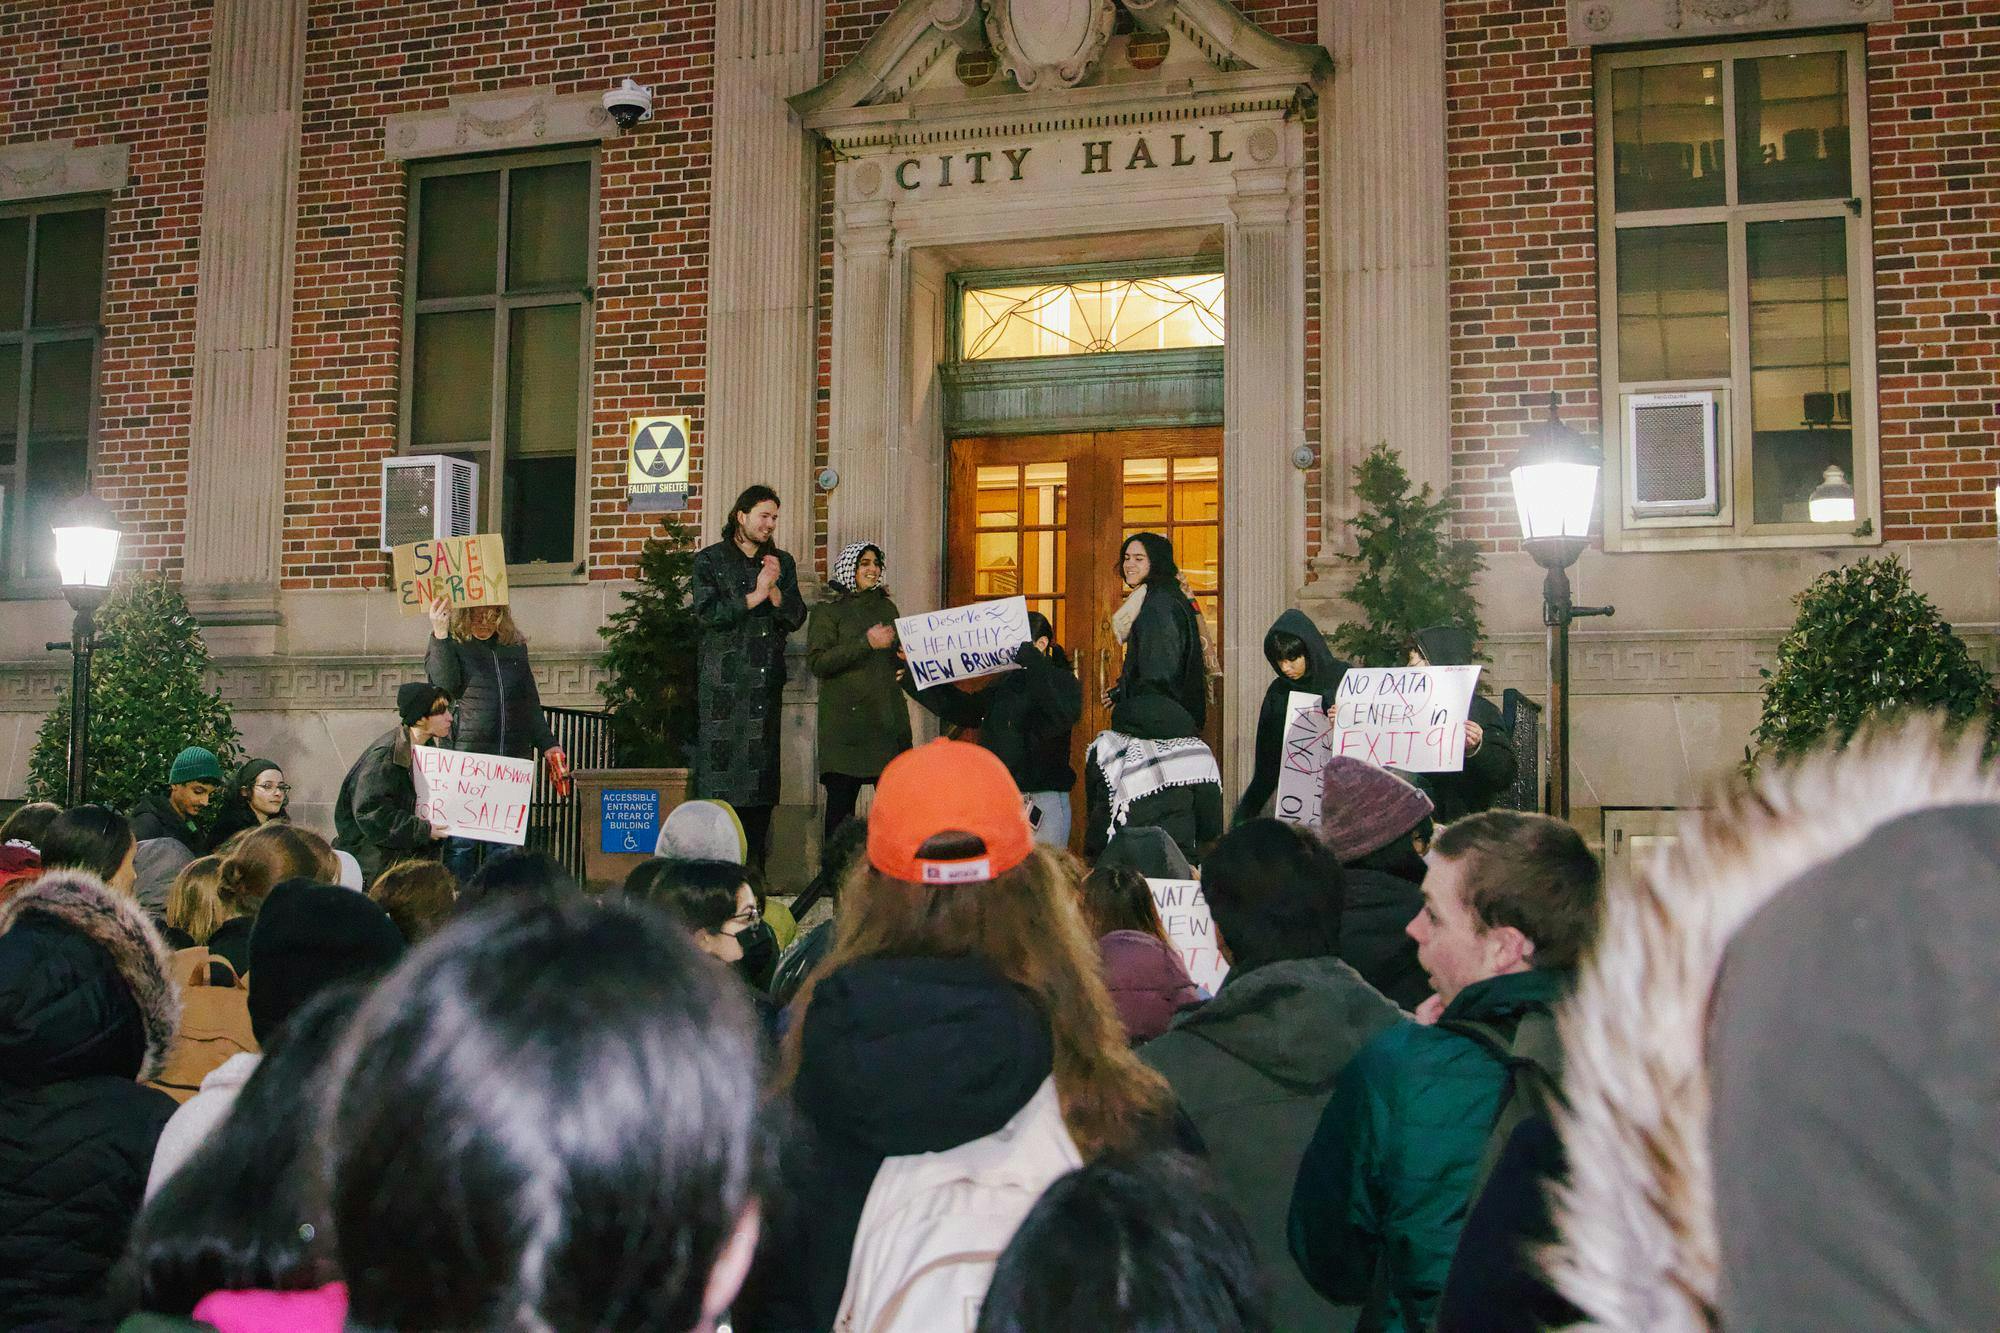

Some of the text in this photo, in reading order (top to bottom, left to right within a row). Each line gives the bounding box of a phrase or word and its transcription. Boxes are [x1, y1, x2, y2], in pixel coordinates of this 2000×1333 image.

[895, 130, 1233, 190] CITY HALL
[628, 482, 688, 494] FALLOUT SHELTER
[414, 539, 481, 577] SAVE
[401, 573, 503, 604] ENERGY
[899, 620, 919, 637] WE
[923, 626, 1001, 655] HEALTHY
[912, 658, 956, 683] NEW
[1340, 672, 1427, 698] NO DATA
[1336, 703, 1448, 729] CENTER in
[1339, 722, 1458, 767] EXIT 9!
[411, 748, 455, 774] NEW
[603, 793, 657, 802] ACCESSIBLE
[607, 803, 653, 811] ENTRANCE
[457, 798, 526, 834] SALE!
[605, 812, 655, 820] AT REAR OF
[610, 821, 650, 830] BUILDING
[1160, 914, 1209, 936] EW
